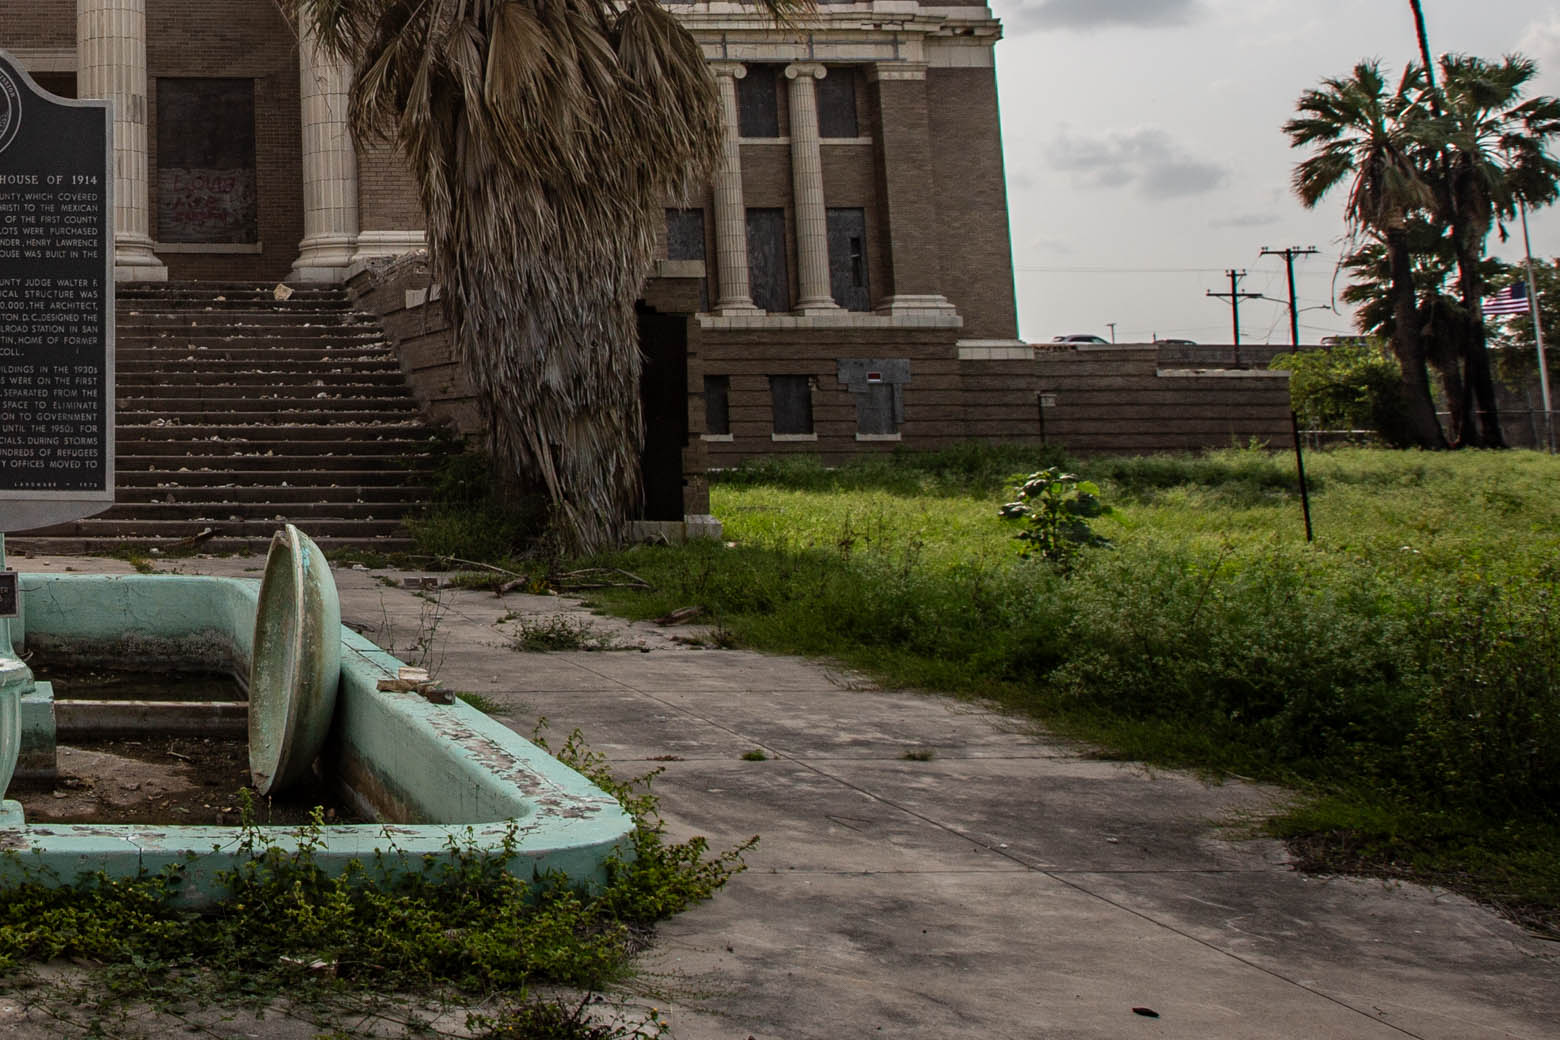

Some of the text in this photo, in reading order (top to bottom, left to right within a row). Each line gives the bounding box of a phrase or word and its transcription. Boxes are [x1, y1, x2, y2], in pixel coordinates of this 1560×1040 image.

[47, 175, 63, 185] OF
[72, 175, 97, 186] 1914
[58, 193, 98, 201] COVERED
[24, 204, 35, 212] TO
[62, 204, 98, 213] MEXICAN
[21, 215, 35, 224] THE
[41, 215, 60, 224] FIRST
[64, 216, 98, 224] COUNTY
[23, 227, 44, 236] WERE
[50, 227, 98, 236] PURCHASED
[56, 239, 98, 247] LAWRENCE
[24, 250, 41, 258] WAS
[46, 250, 66, 259] BUILT
[84, 250, 98, 259] THE
[25, 278, 51, 287] JUDGE
[57, 279, 88, 287] WALTER
[25, 290, 74, 299] STRUCTURE
[80, 290, 98, 299] WAS
[83, 314, 98, 322] THE
[32, 325, 65, 334] STATION
[82, 325, 98, 334] SAN
[47, 336, 58, 345] OF
[64, 336, 98, 345] FORMER
[40, 365, 48, 374] IN
[54, 366, 68, 374] THE
[10, 376, 31, 385] WERE
[37, 376, 50, 385] ON
[55, 377, 70, 385] THE
[76, 377, 97, 385] FIRST
[54, 389, 78, 398] FROM
[82, 389, 98, 398] THE
[3, 401, 28, 409] SPACE
[35, 401, 47, 410] TO
[53, 401, 98, 410] ELIMINATE
[20, 412, 32, 421] TO
[37, 413, 97, 422] GOVERNMENT
[2, 424, 24, 433] UNTIL
[81, 425, 98, 434] FOR
[64, 437, 98, 446] STORMS
[57, 449, 98, 457] REFUGEES
[10, 460, 44, 468] OFFICES
[50, 460, 80, 469] MOVED
[86, 460, 98, 469] TO
